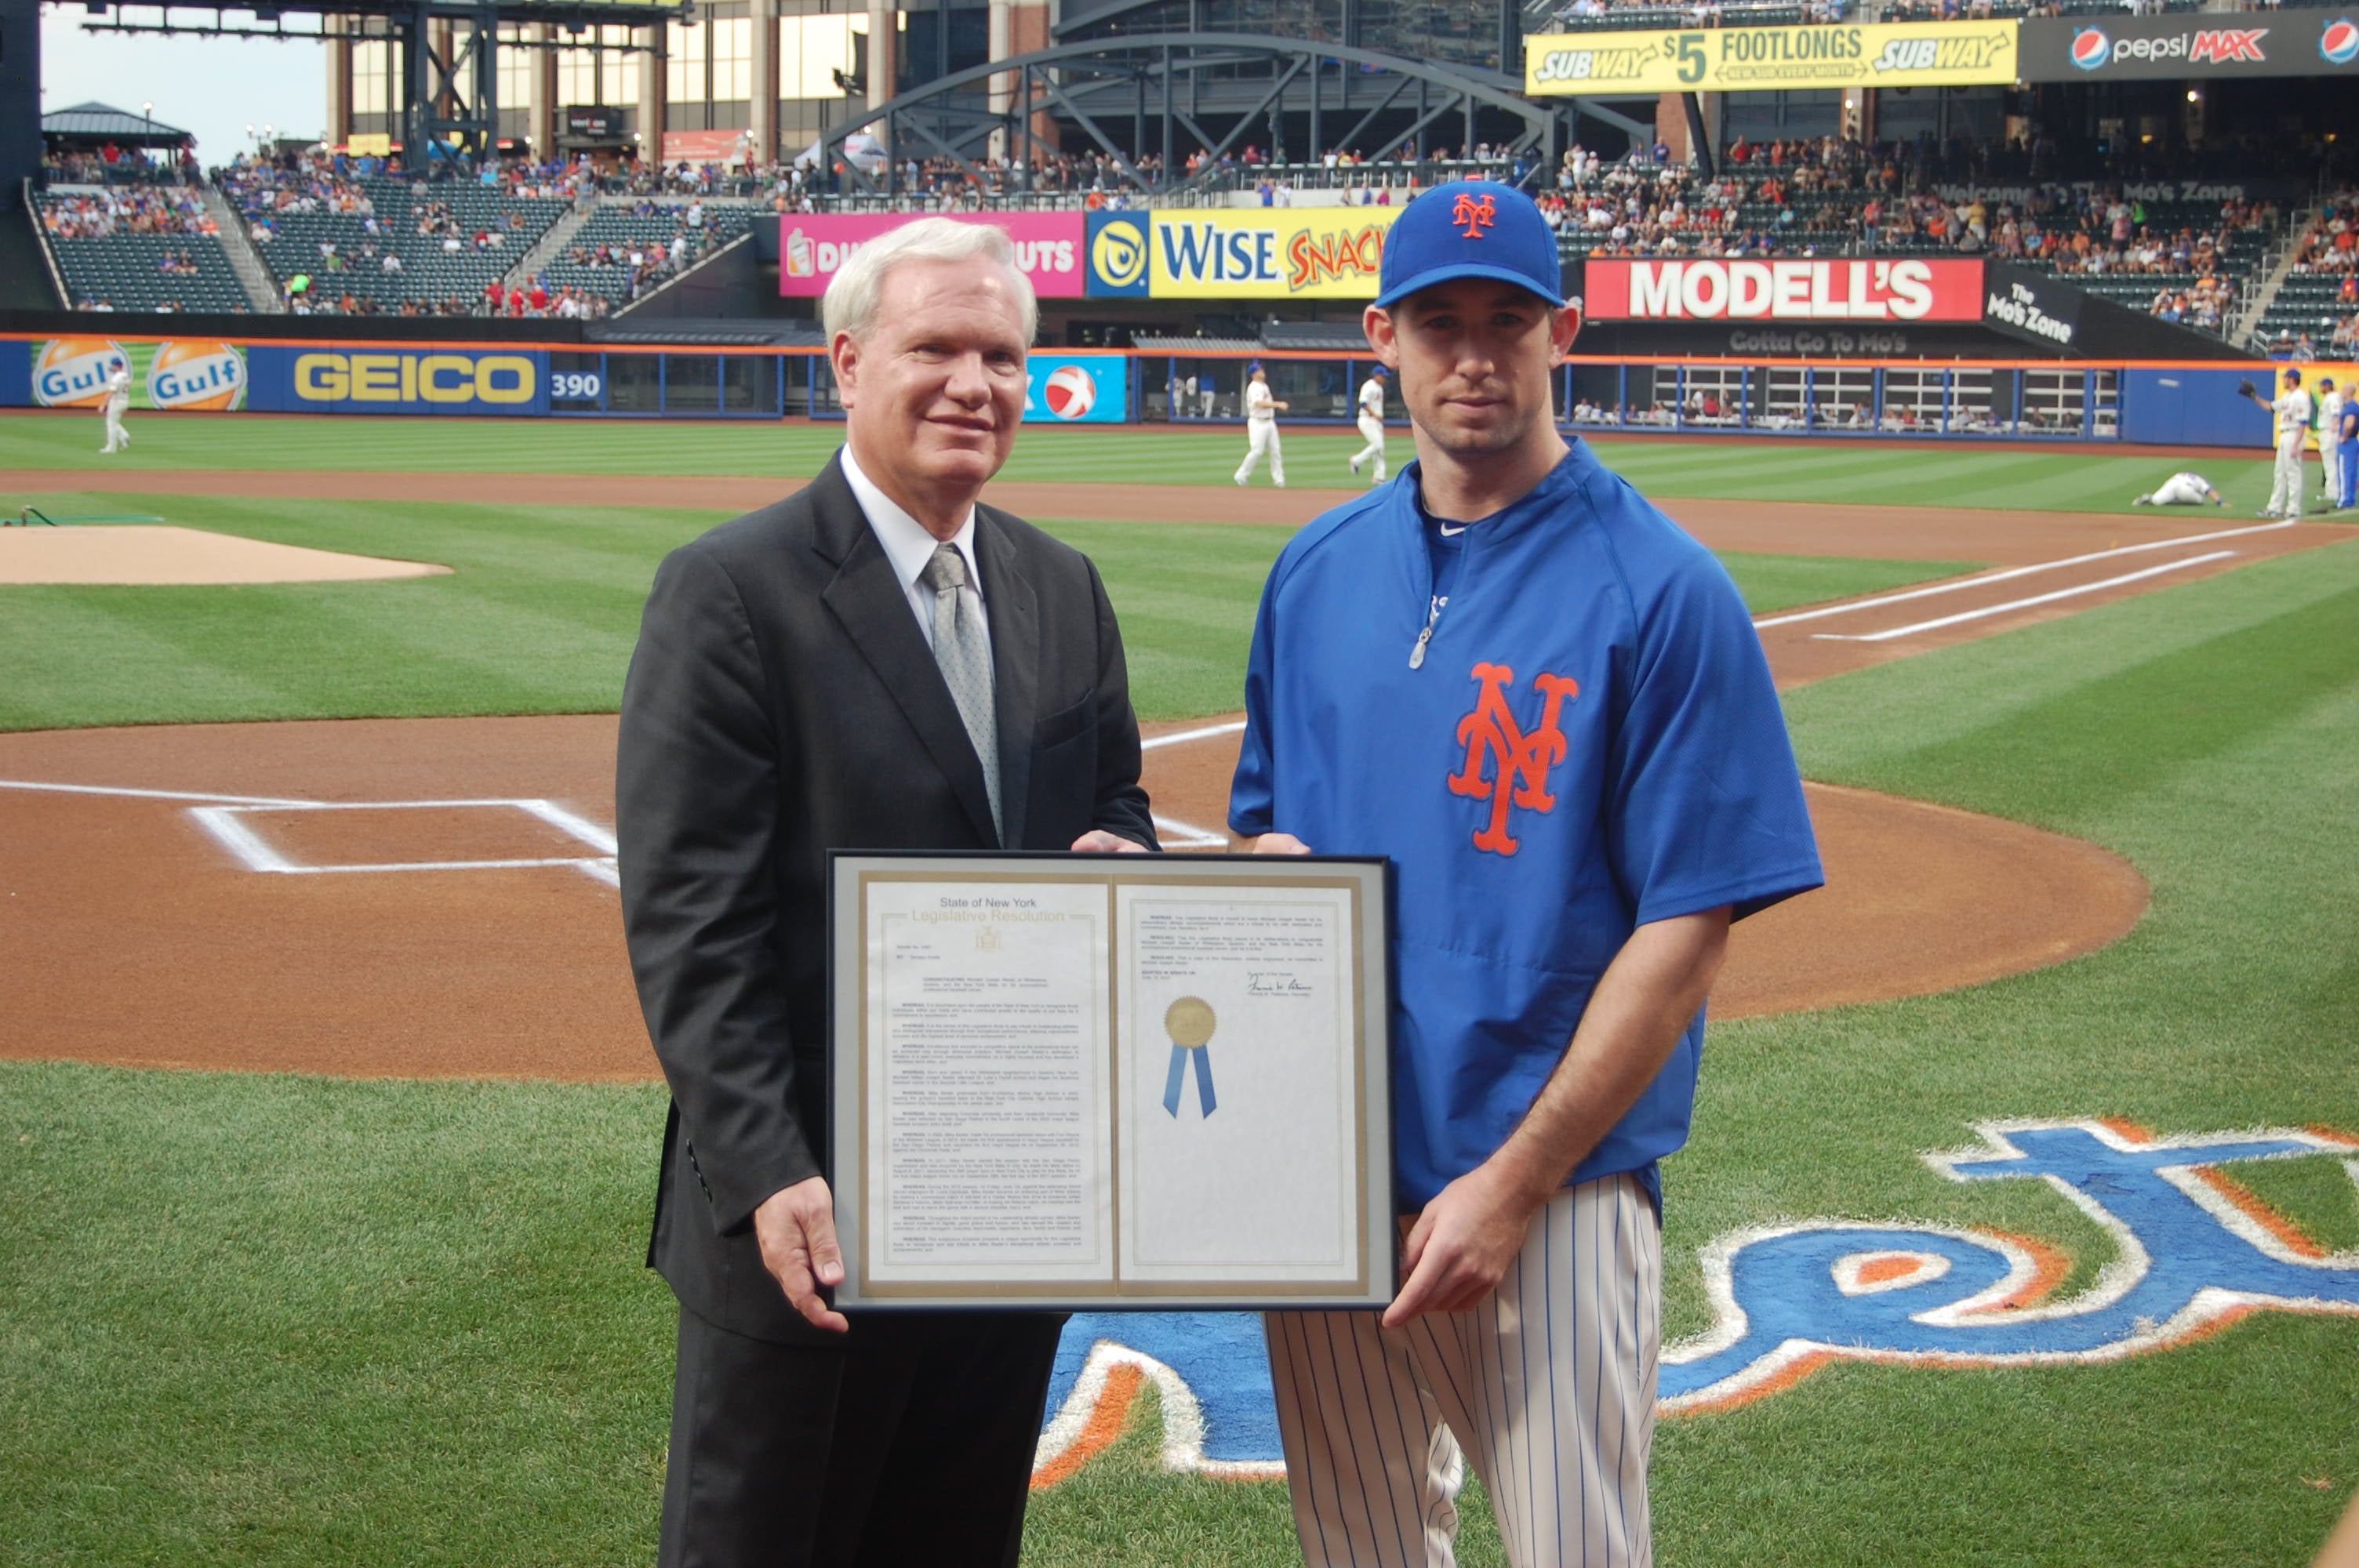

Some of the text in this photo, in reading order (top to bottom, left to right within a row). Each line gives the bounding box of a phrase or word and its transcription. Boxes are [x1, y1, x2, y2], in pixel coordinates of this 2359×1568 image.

[1535, 42, 1659, 84] SUBWAY
[1663, 29, 1862, 83] $5 FOOTLONGS
[1871, 32, 2010, 74] SUBWAY
[2113, 28, 2270, 64] pepsi MAX
[1726, 64, 1855, 81] NEW SUB EVERY MONTH
[2123, 183, 2174, 203] Mo's
[2180, 181, 2245, 201] Zone
[1159, 224, 1387, 290] WISE SNAC
[1628, 260, 1933, 320] MODELL'S
[2012, 282, 2035, 305] The
[1987, 292, 2073, 343] Mo's Zone
[1729, 331, 1907, 353] Gotta Go To Mo's
[42, 361, 107, 397] Gul
[156, 360, 236, 400] Gulf
[294, 353, 536, 404] GEICO
[551, 373, 601, 397] 390
[912, 909, 1065, 924] Legislative Resolution
[940, 897, 1037, 909] State of New York
